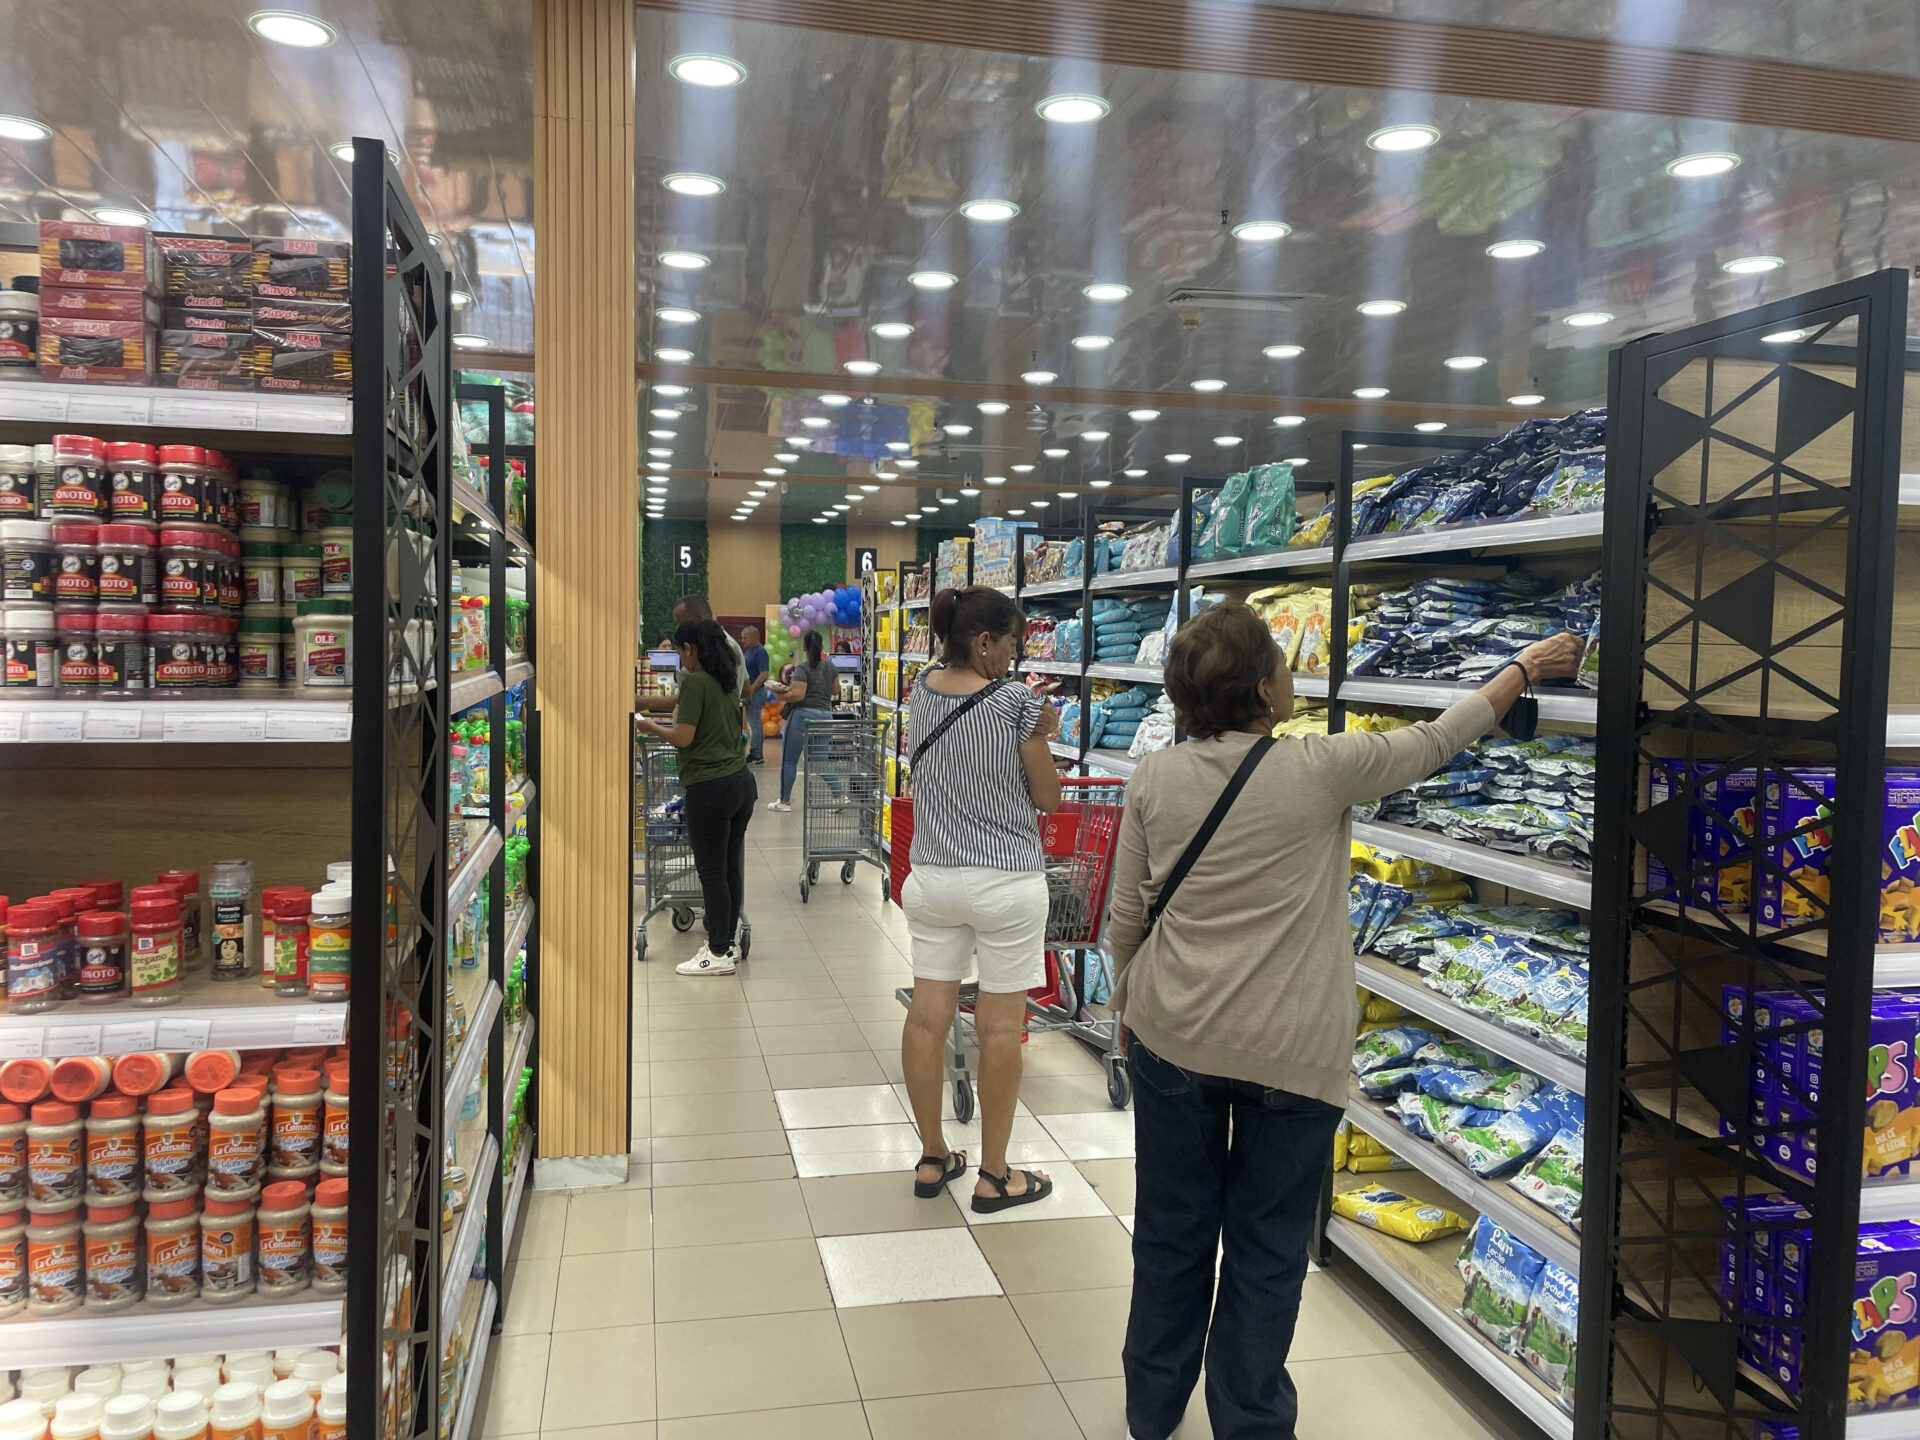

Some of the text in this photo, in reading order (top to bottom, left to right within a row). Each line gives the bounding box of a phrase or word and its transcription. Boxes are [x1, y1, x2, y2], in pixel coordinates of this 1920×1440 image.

[259, 284, 296, 297] Clavos
[185, 295, 224, 307] Canela
[259, 307, 298, 319] Clavos
[185, 317, 226, 330] Canela
[261, 376, 300, 389] Clavos
[56, 490, 92, 500] ONOTO
[680, 546, 692, 569] 5
[861, 551, 872, 571] 6
[314, 632, 336, 645] OLÉ
[62, 666, 97, 675] ONOTO
[163, 665, 194, 675] ONOT
[972, 680, 1004, 703] ELEPH
[927, 708, 962, 745] ELEPHANT
[82, 968, 115, 979] ONOTO
[276, 1124, 284, 1132] La
[330, 1122, 340, 1131] La
[1875, 1127, 1896, 1144] DULCE
[148, 1143, 191, 1155] La Comadre
[214, 1144, 257, 1155] La Comadre
[91, 1151, 100, 1160] La
[268, 1239, 303, 1249] Comadre
[160, 1251, 171, 1261] La
[1487, 1243, 1506, 1264] Leche
[35, 1259, 45, 1270] La
[91, 1257, 101, 1267] La
[1543, 1276, 1564, 1299] Leche
